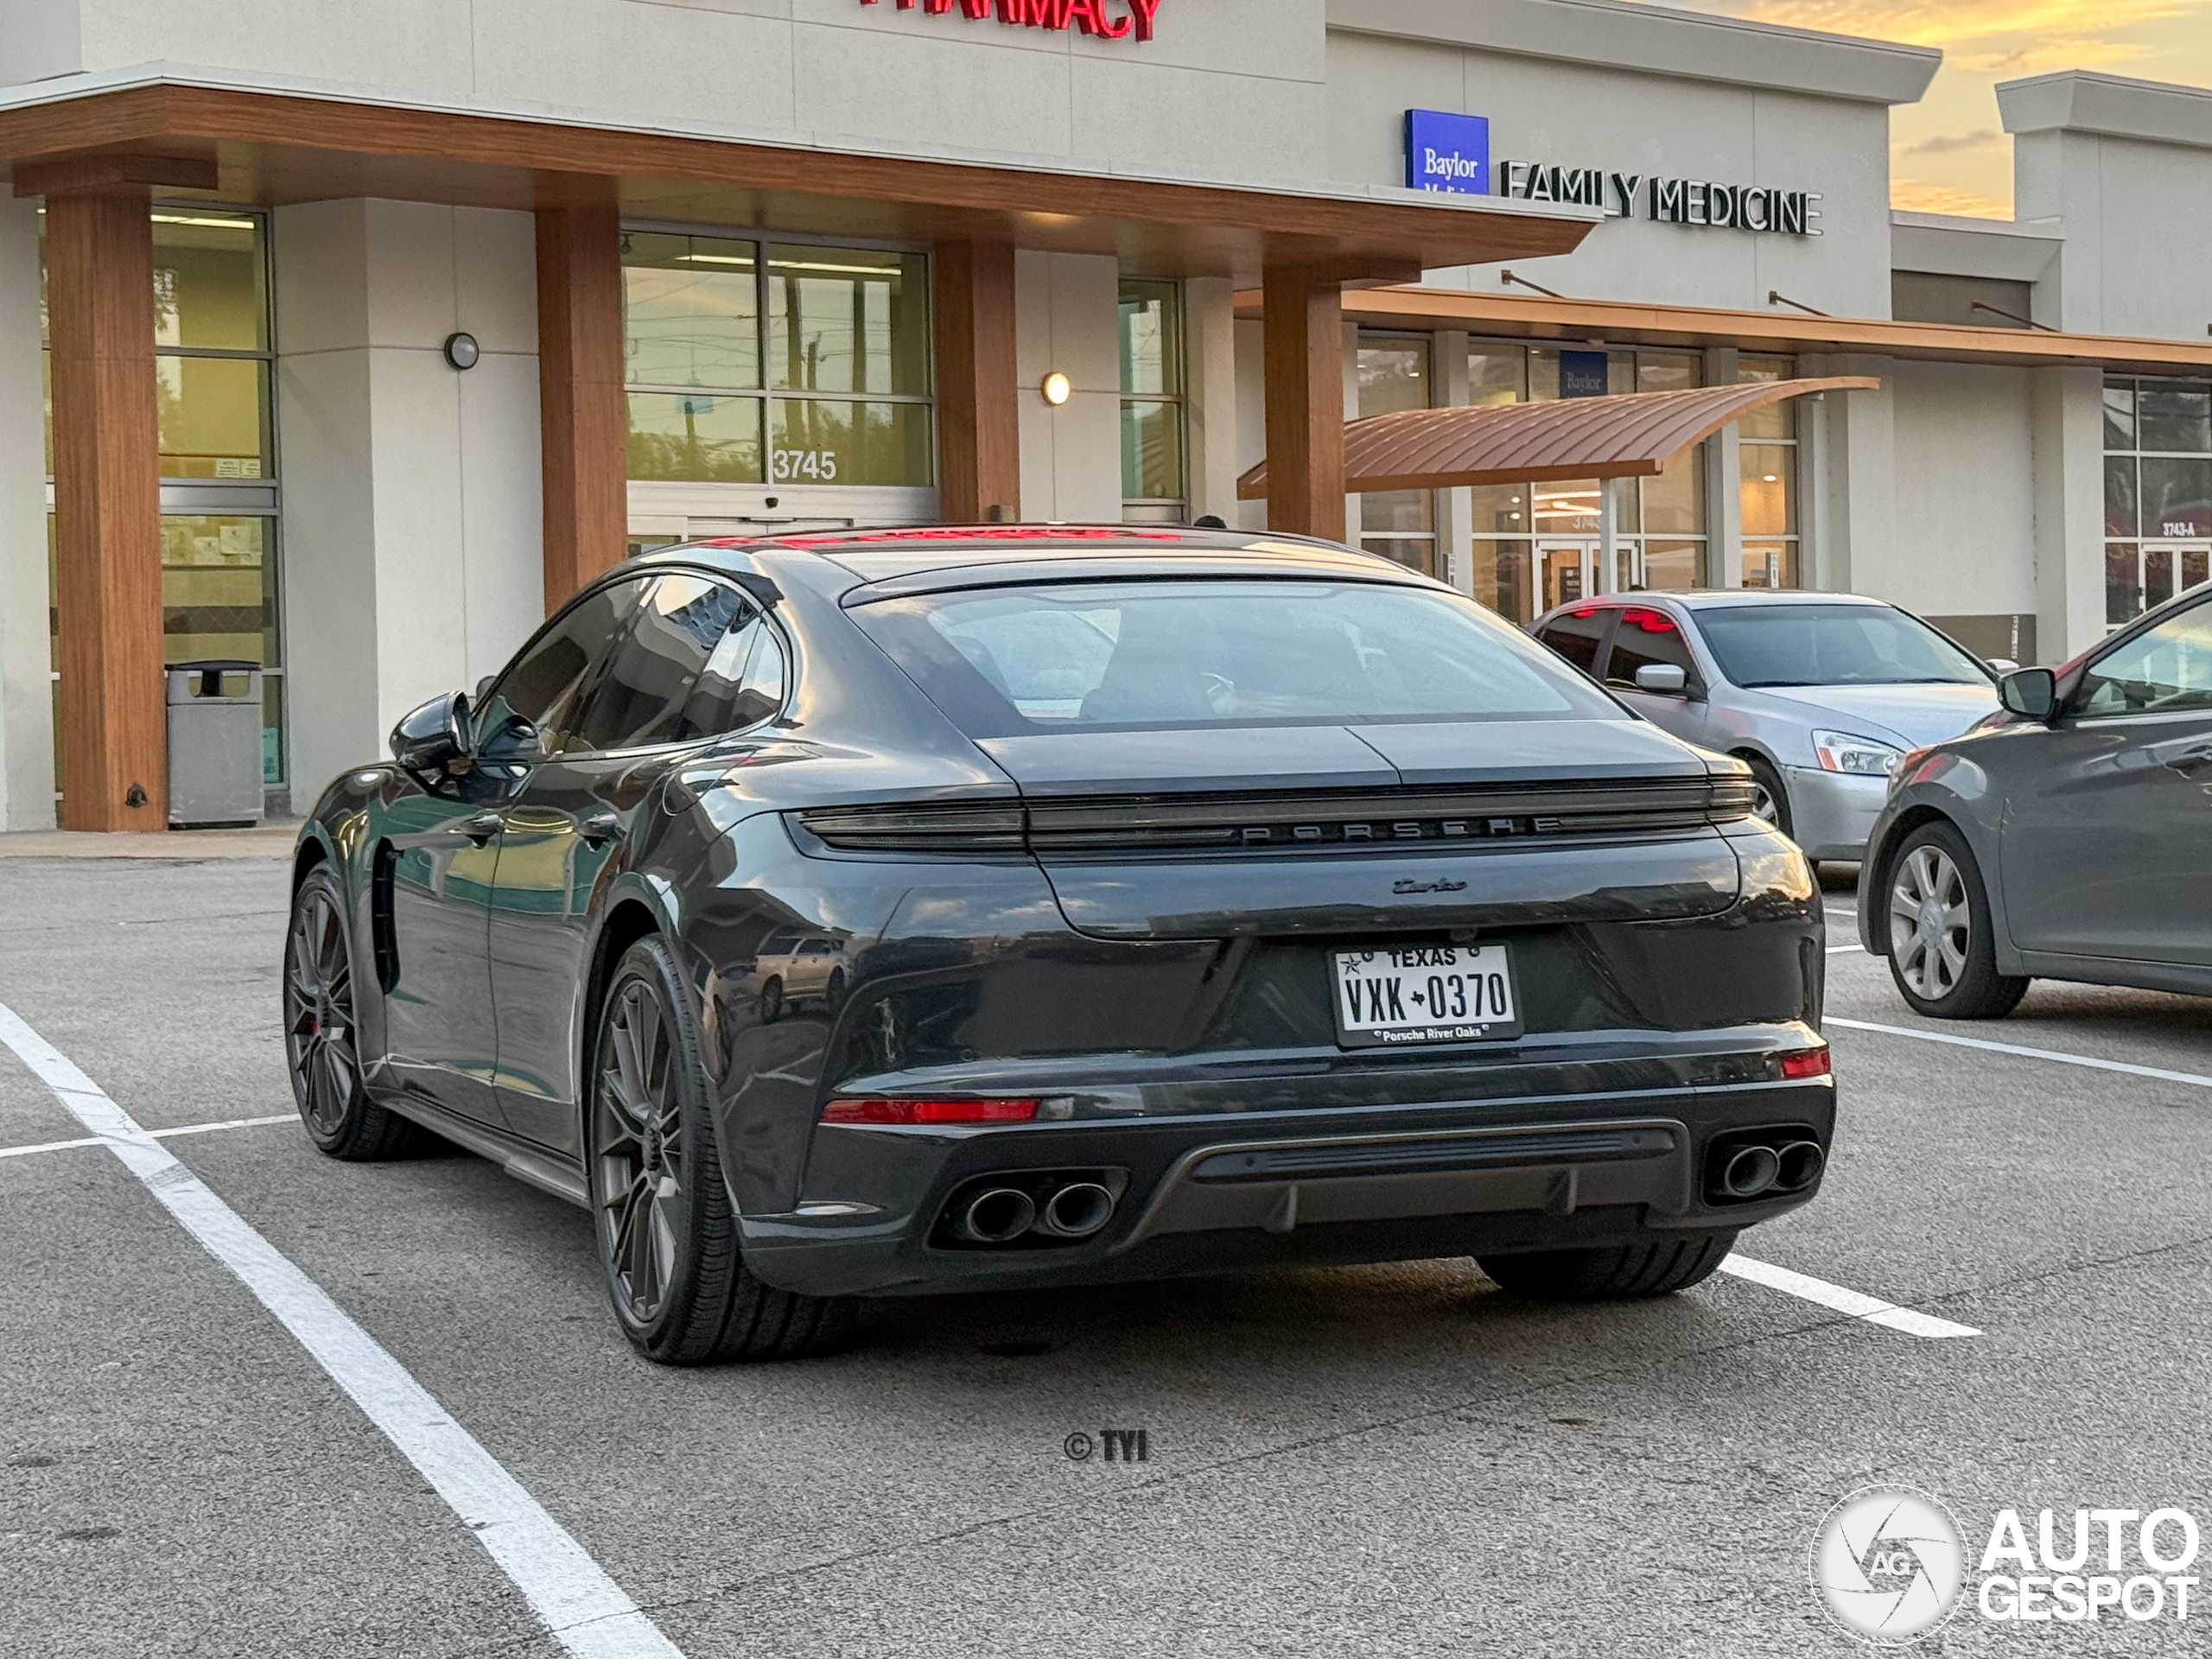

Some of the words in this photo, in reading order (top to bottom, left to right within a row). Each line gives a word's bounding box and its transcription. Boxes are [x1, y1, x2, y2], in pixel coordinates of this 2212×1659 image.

[1424, 147, 1478, 181] Baylor
[1501, 160, 1643, 219] FAMILY
[1646, 176, 1824, 237] MEDICINE
[1567, 372, 1602, 393] Baylor
[773, 449, 837, 480] 3745
[2162, 521, 2196, 537] 3743-A
[1242, 817, 1560, 841] PORSCHE
[1392, 876, 1468, 895] Turbo
[1387, 948, 1458, 969] TEXAS
[1344, 976, 1408, 1023] VXK
[1427, 973, 1508, 1020] 0370
[1382, 1030, 1426, 1042] Porsche
[1427, 1027, 1454, 1040] River
[1455, 1027, 1482, 1038] Oaks
